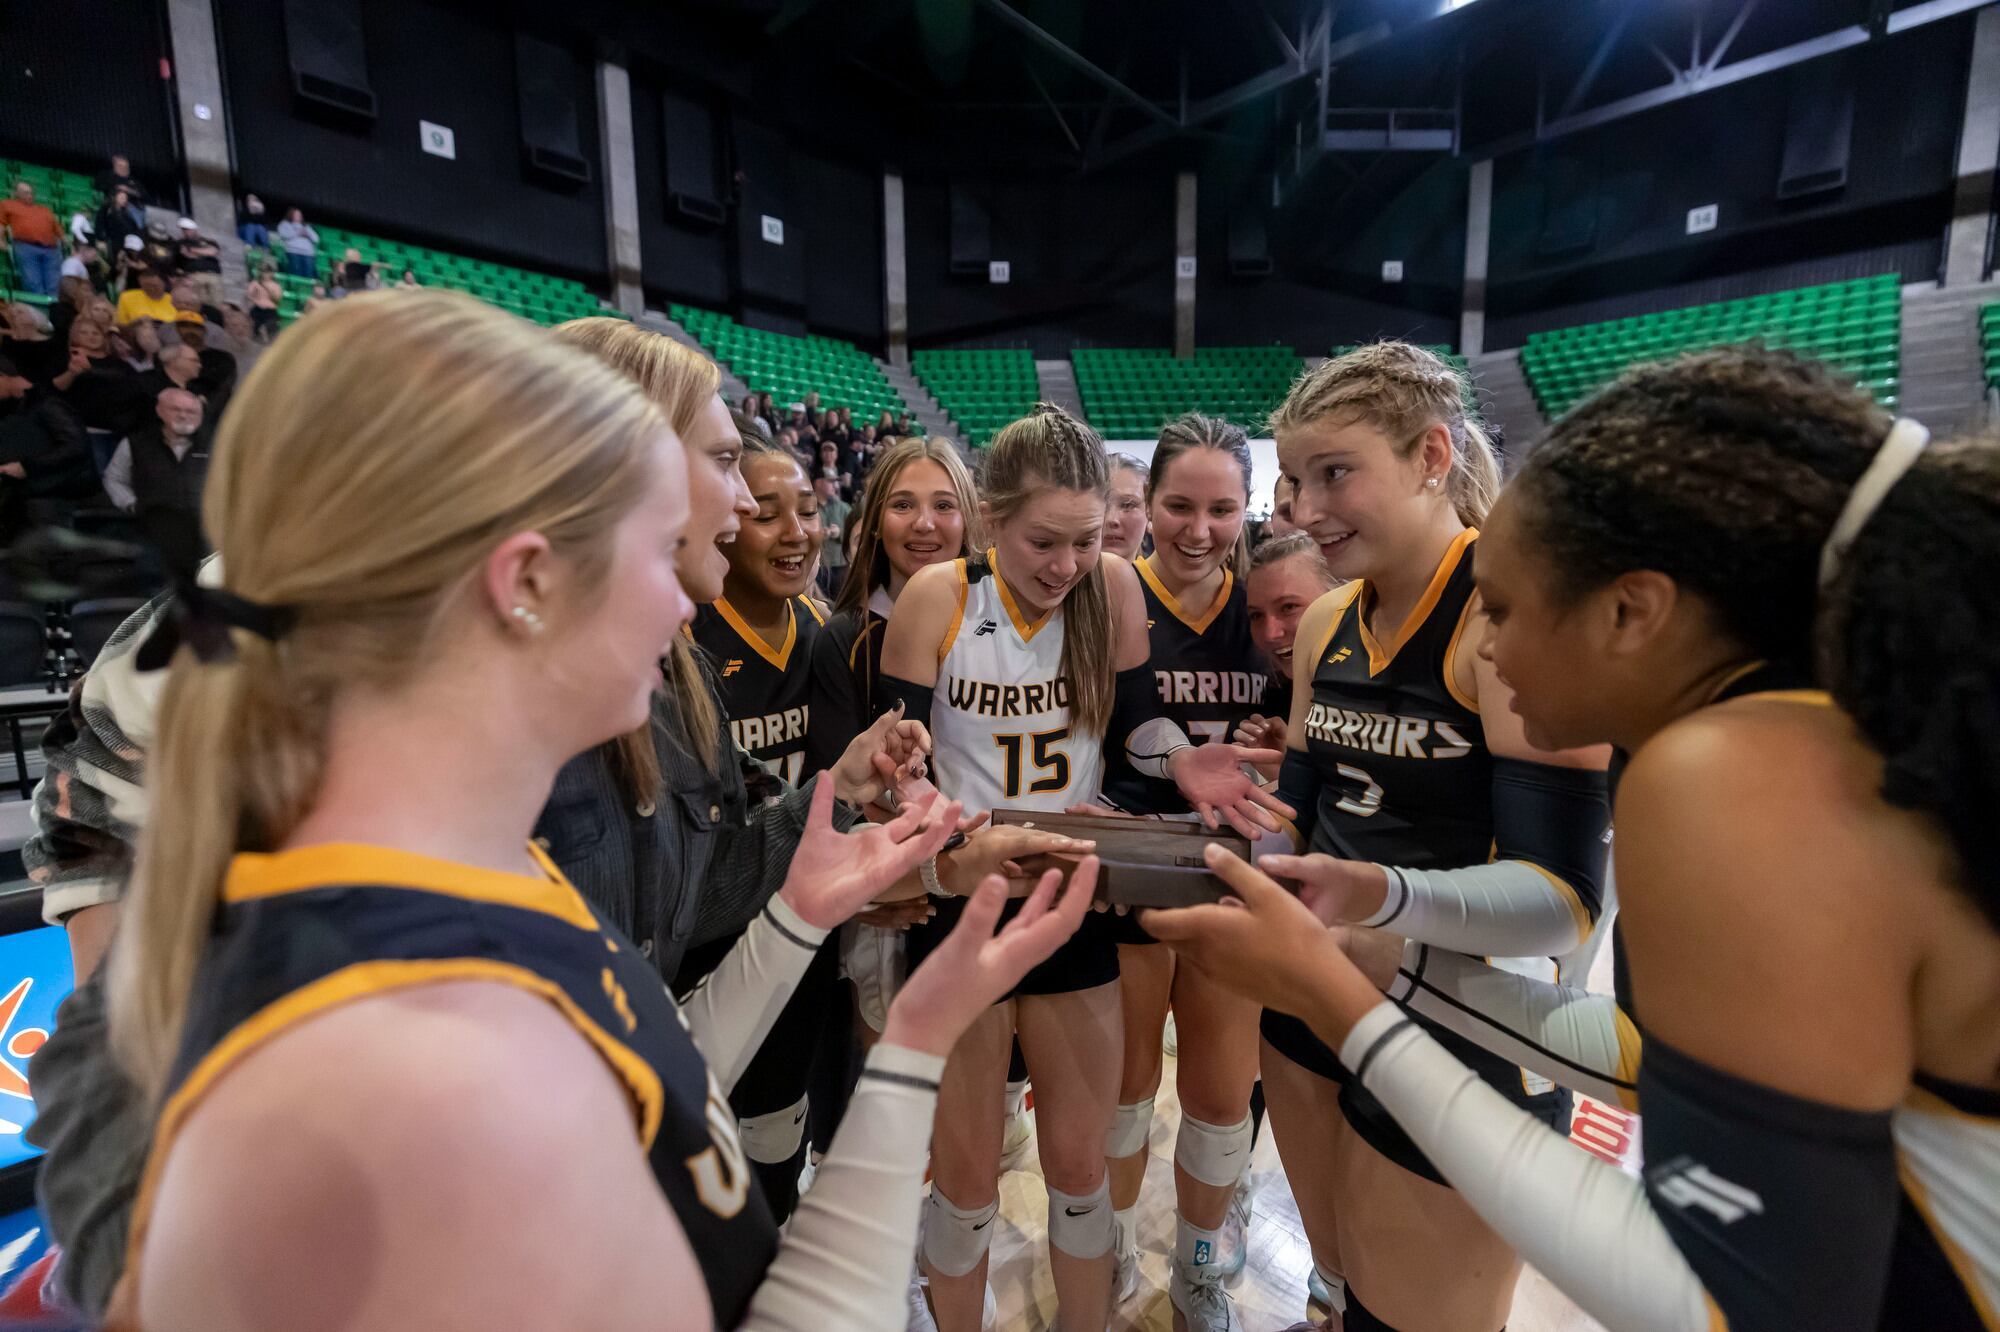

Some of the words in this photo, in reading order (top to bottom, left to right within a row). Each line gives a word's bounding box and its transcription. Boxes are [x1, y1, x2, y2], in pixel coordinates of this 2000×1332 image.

[1155, 670, 1268, 704] ARRIOR
[1305, 703, 1473, 759] ARRIORS
[991, 728, 1071, 799] 15
[1335, 762, 1384, 817] 3
